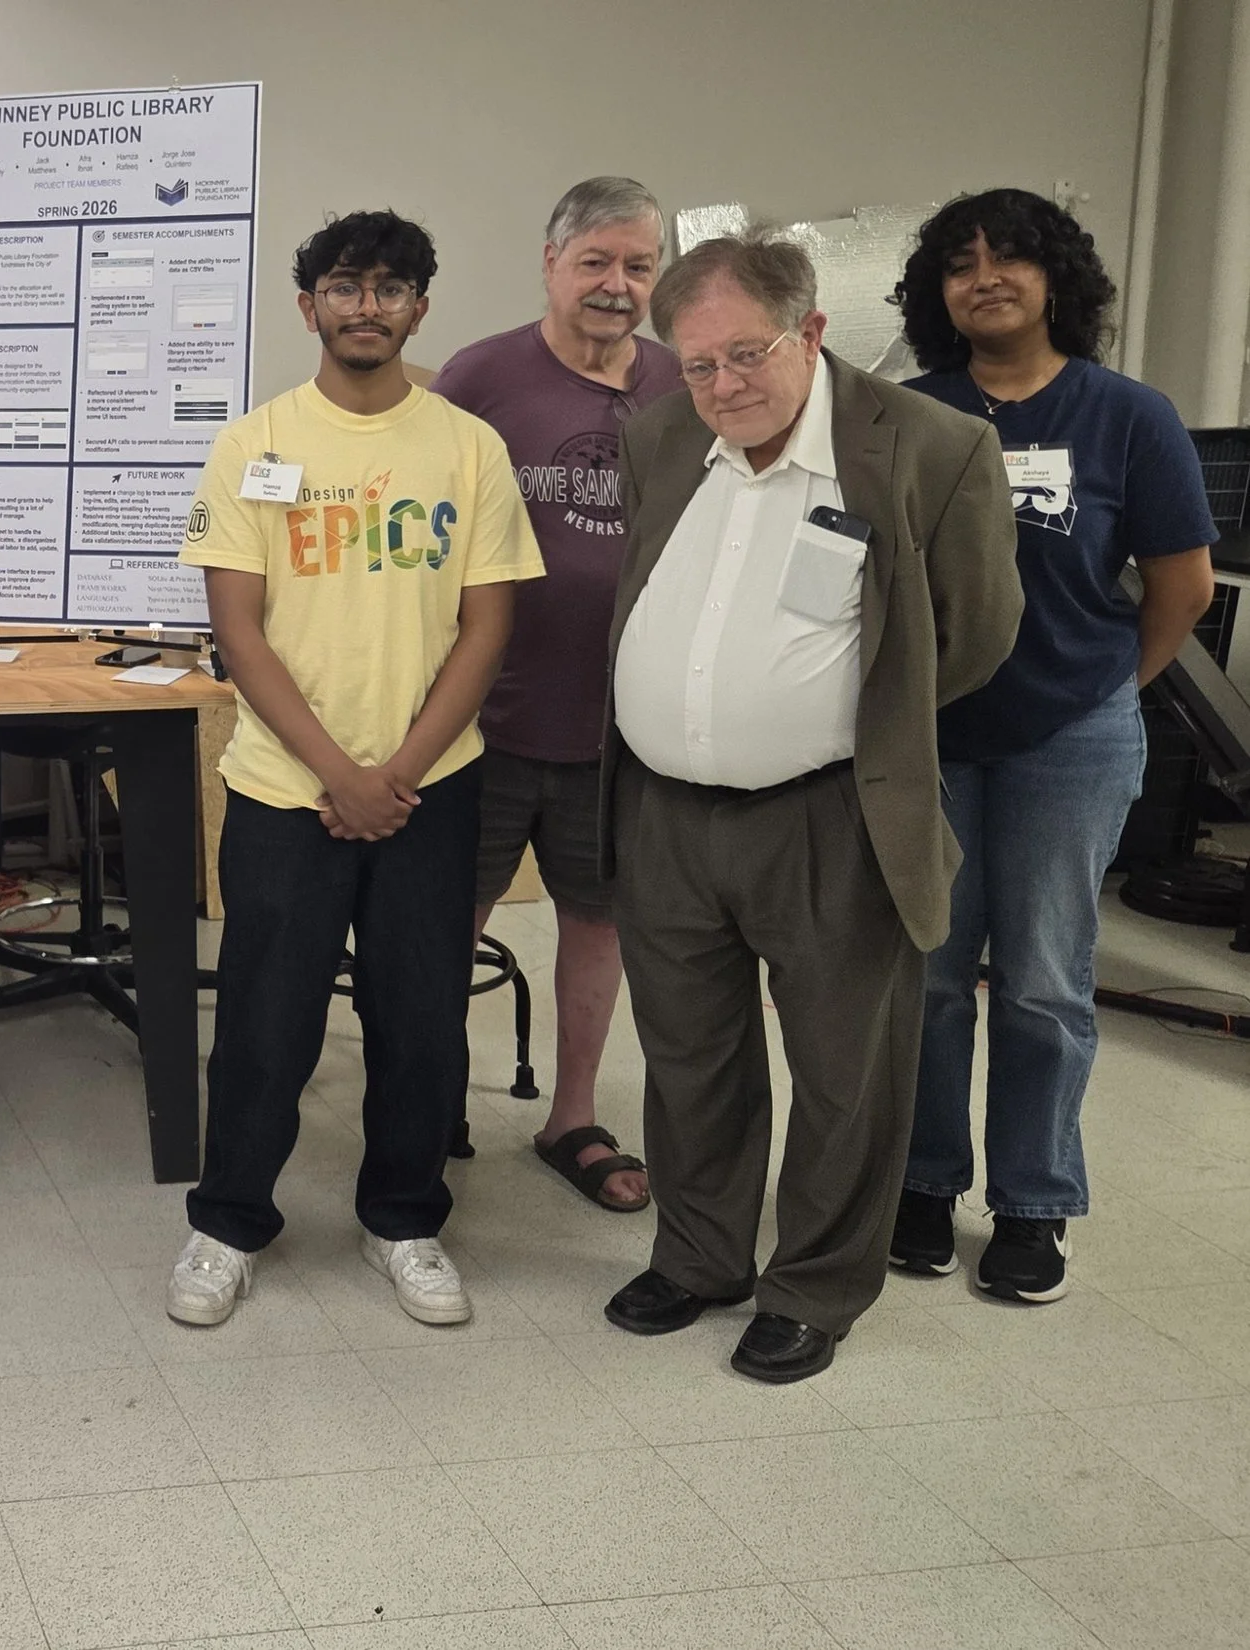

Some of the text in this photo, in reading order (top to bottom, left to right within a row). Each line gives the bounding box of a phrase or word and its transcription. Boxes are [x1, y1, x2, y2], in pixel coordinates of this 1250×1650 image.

[57, 100, 124, 121] PUBLIC
[131, 96, 214, 117] LIBRARY
[22, 125, 141, 148] FOUNDATION
[161, 151, 179, 159] Jorge
[164, 160, 191, 169] Quintero
[33, 181, 65, 189] PROJECT
[86, 179, 121, 187] MEMBERS
[38, 200, 118, 218] SPRING 2026
[112, 228, 234, 240] SEMESTER ACCOMPLISHMENTS
[127, 471, 185, 479] FUTURE WORK
[511, 466, 622, 507] OWE SAN
[302, 486, 355, 503] Design
[285, 498, 458, 578] EPICS
[126, 560, 179, 569] REFERENCES
[76, 605, 133, 613] AUTHORIZATION
